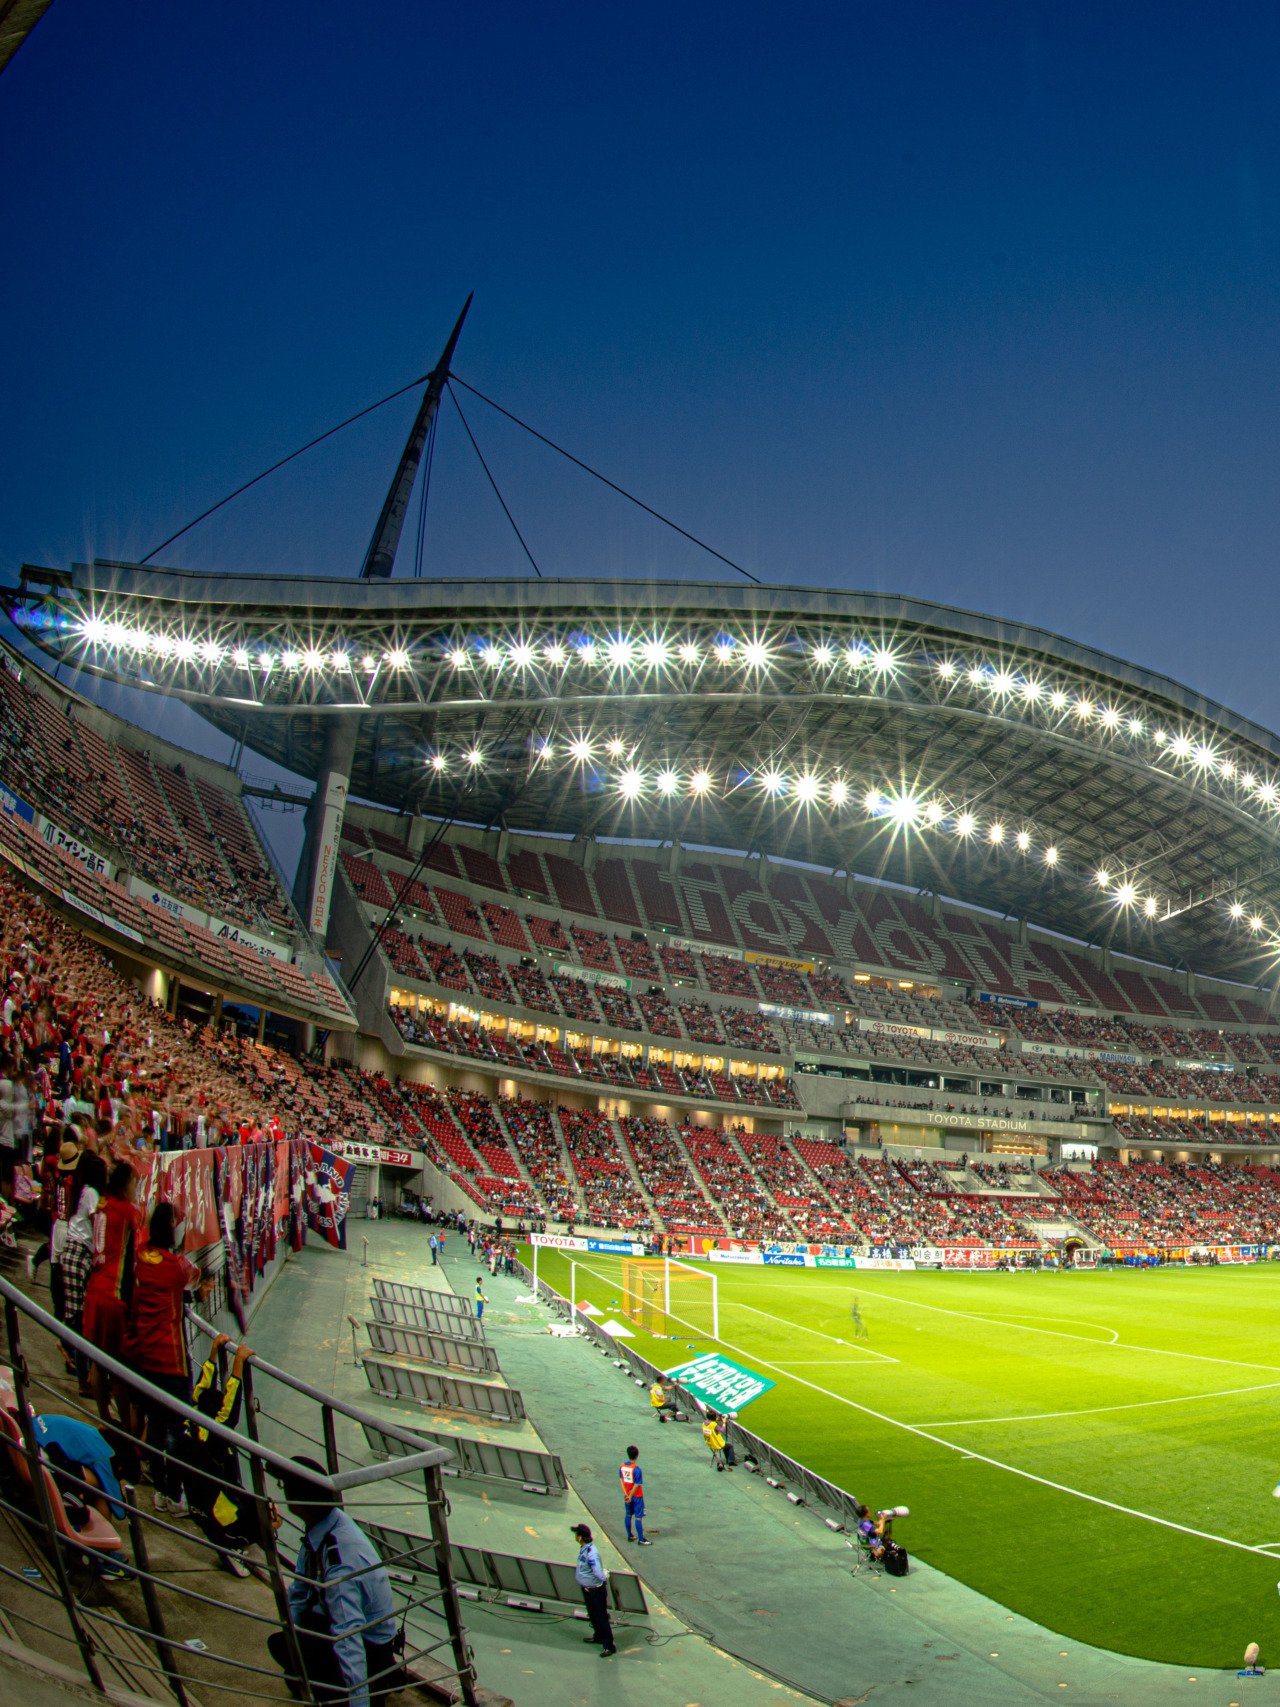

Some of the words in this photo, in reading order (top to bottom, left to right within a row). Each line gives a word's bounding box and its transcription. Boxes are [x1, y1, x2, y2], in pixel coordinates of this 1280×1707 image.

[658, 870, 1082, 1000] TOYOTA
[886, 1024, 919, 1036] TOYOTA
[957, 1034, 988, 1046] TOYOTA
[1100, 1052, 1136, 1064] MARUYASU
[928, 1113, 972, 1127] TOYOTA
[977, 1118, 1027, 1131] STADIUM
[533, 1235, 576, 1247] TOYOTA
